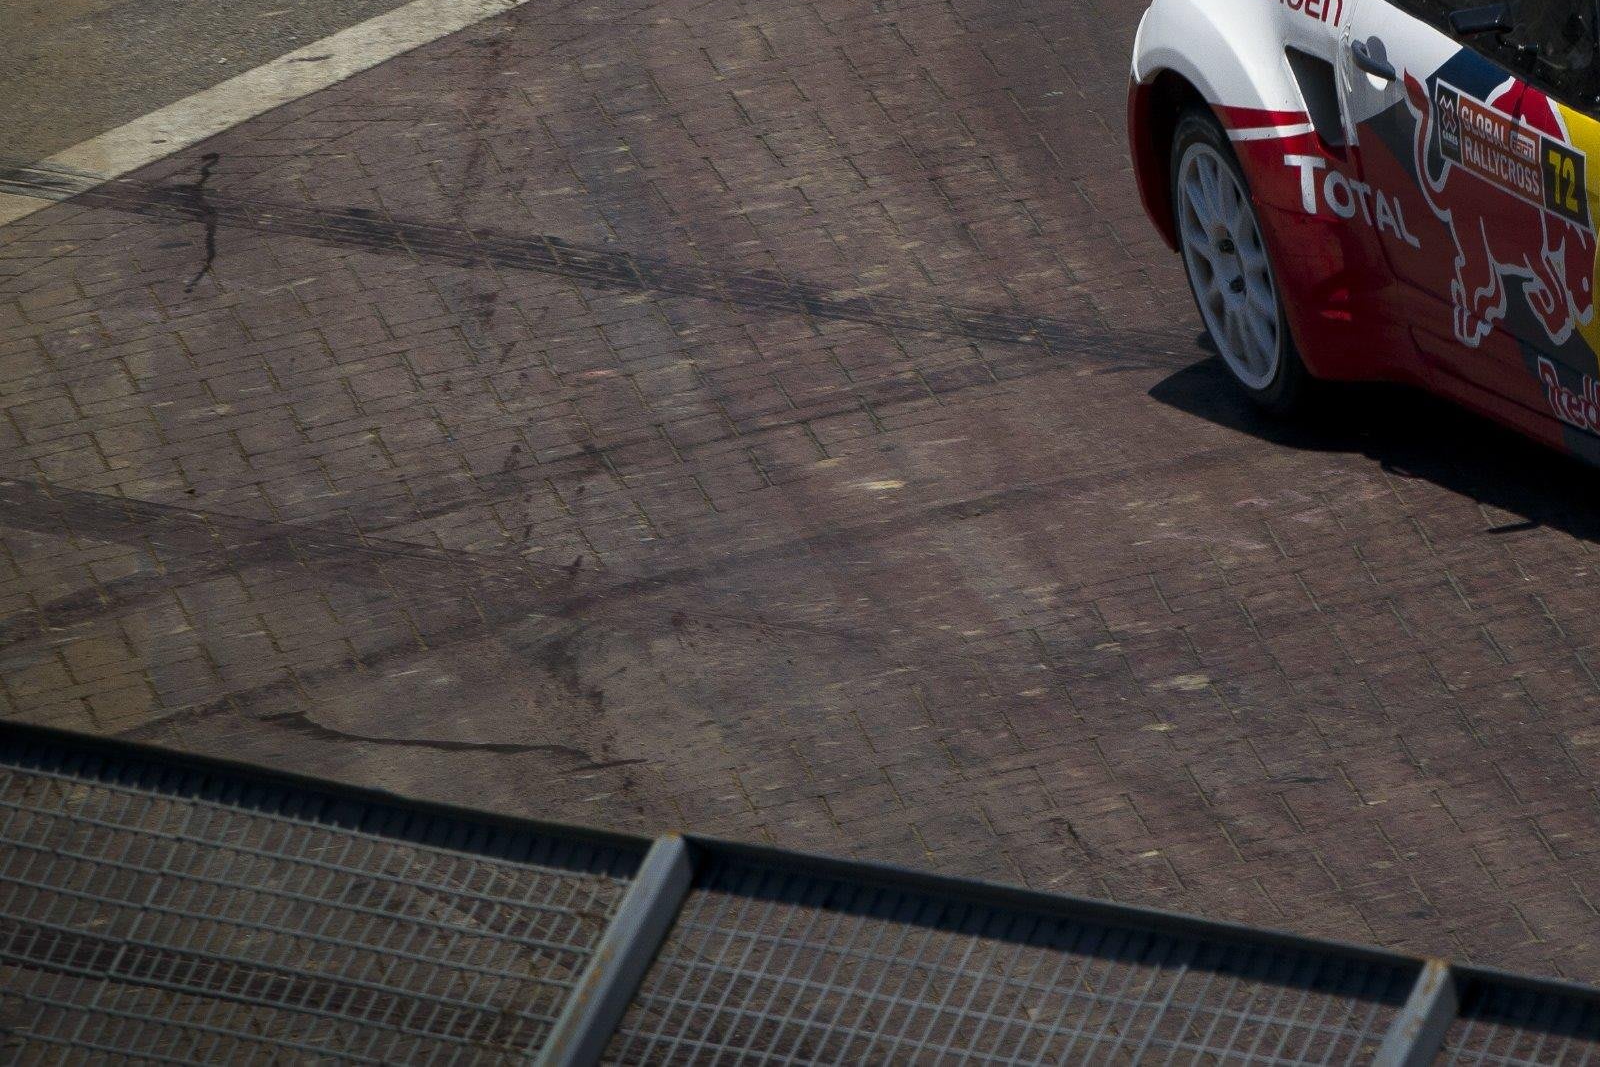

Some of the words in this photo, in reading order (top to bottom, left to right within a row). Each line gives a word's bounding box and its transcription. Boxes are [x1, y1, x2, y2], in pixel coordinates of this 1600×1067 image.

[1461, 106, 1510, 152] GLOBAL
[1464, 136, 1541, 196] RALLYCROSS
[1549, 149, 1579, 213] 72
[1283, 154, 1421, 250] TOTAL
